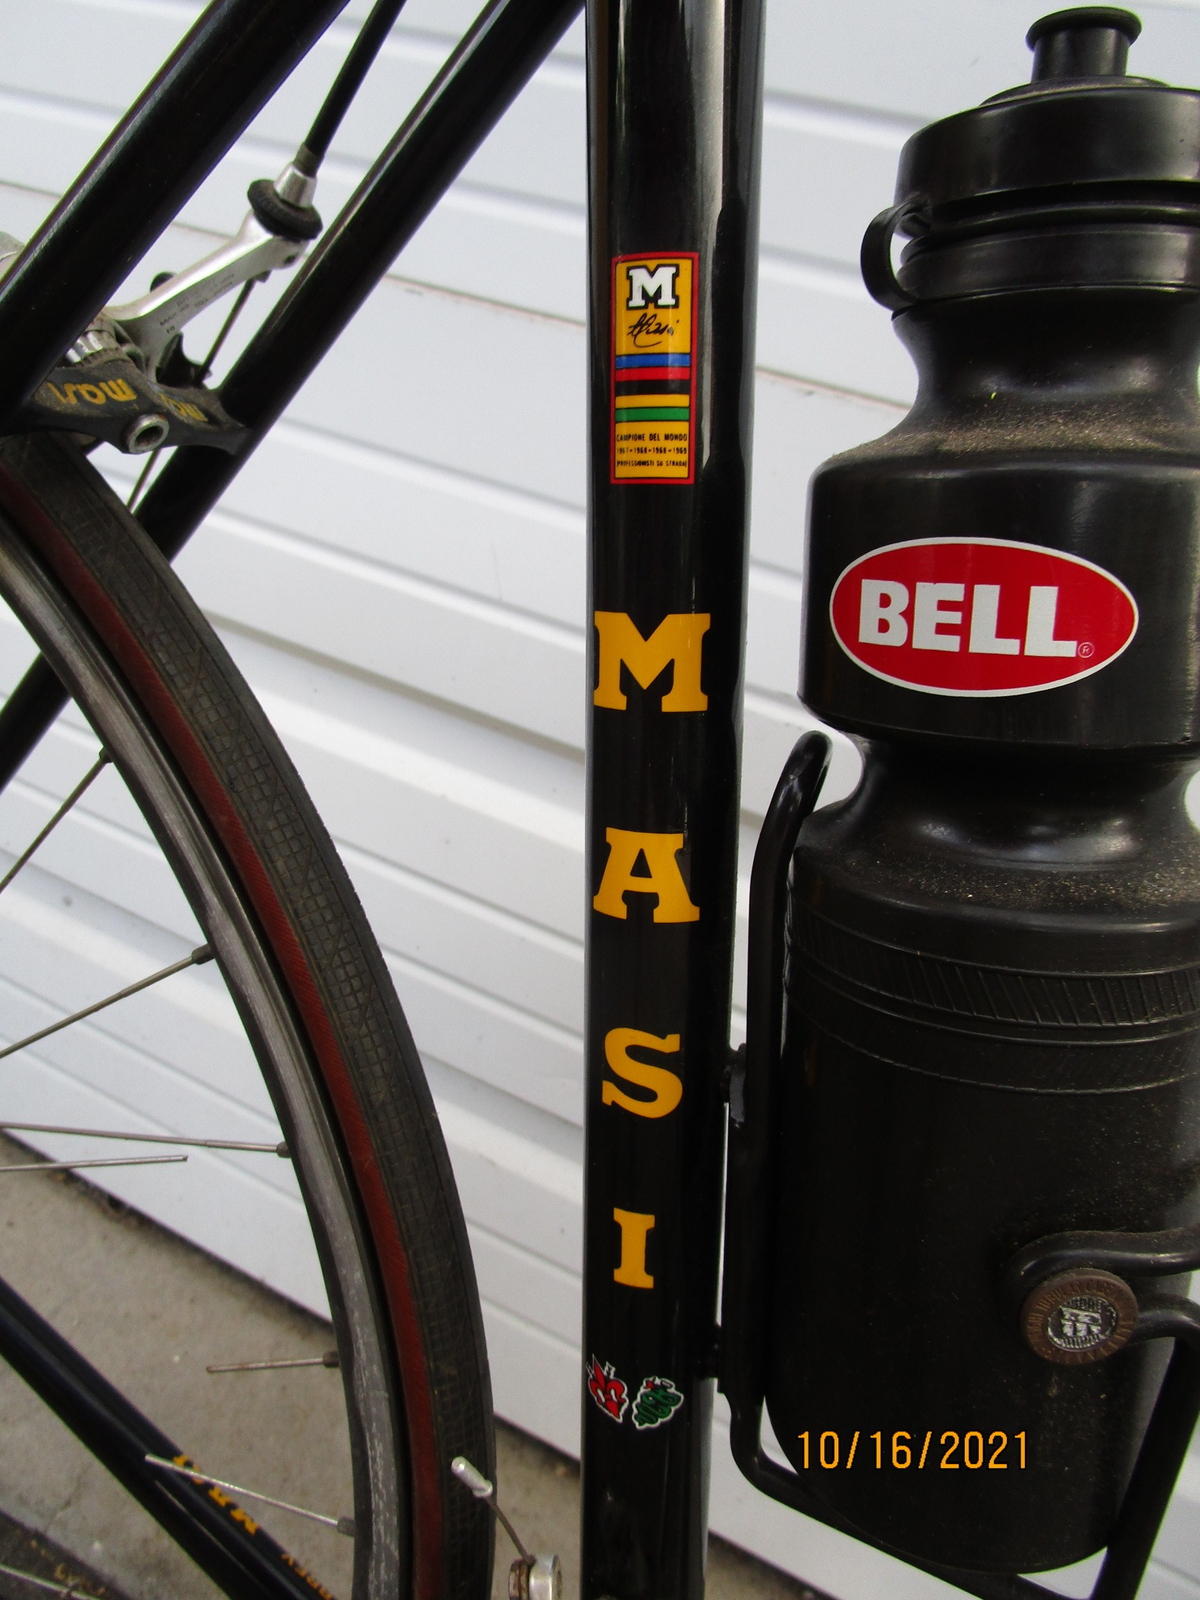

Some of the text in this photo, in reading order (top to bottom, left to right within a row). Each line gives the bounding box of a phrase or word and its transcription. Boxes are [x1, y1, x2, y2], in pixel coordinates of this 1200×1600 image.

[627, 265, 679, 310] M
[616, 433, 687, 442] CAMPIONE DEL MONDO
[858, 579, 1077, 658] BELL
[593, 611, 711, 1289] MASI
